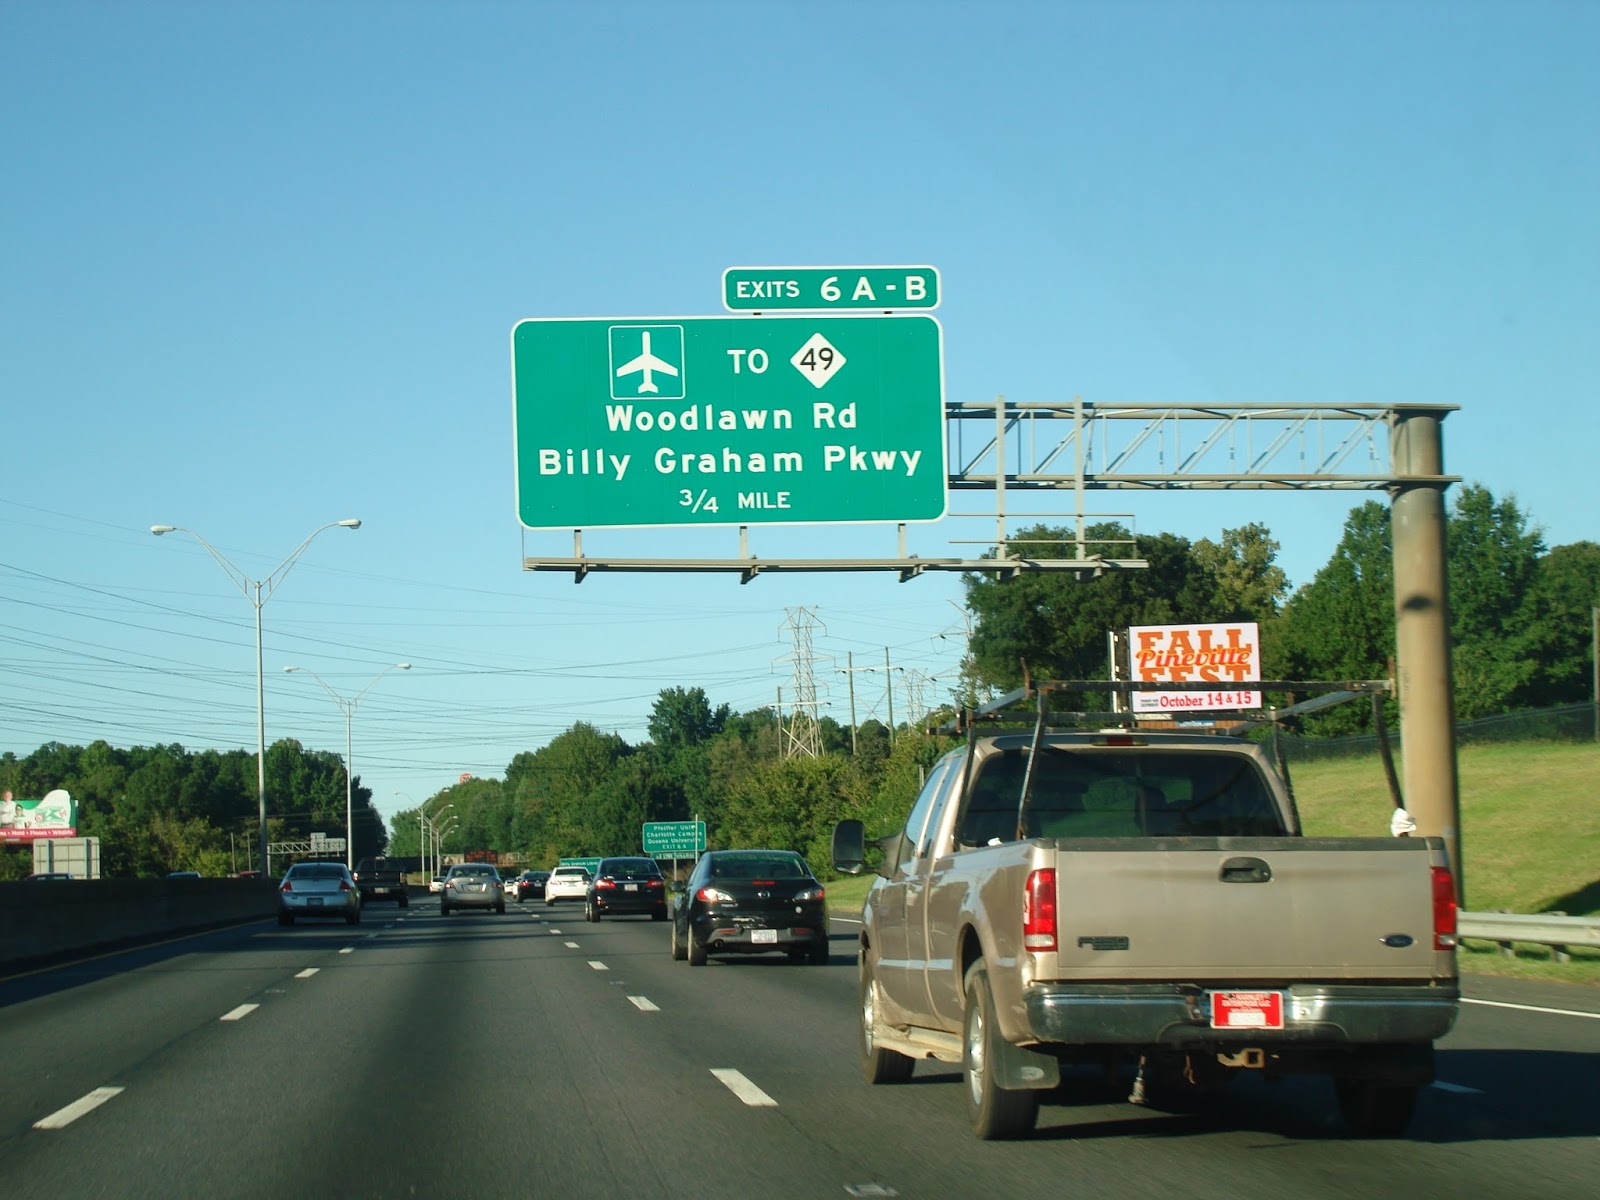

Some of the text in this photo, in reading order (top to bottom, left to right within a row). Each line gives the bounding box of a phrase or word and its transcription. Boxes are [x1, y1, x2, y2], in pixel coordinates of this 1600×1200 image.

[736, 280, 800, 299] EXITS
[820, 276, 841, 302] 6
[852, 276, 876, 301] A
[905, 276, 927, 301] B
[727, 349, 769, 374] TO
[800, 347, 833, 371] 49
[605, 402, 857, 432] Woodlawn Rd
[539, 445, 922, 480] Billy Graham Pkwy
[679, 488, 791, 513] 3/4 MILE
[1137, 629, 1252, 655] FALL
[1136, 647, 1251, 667] Pineville
[1160, 695, 1204, 707] October
[1207, 692, 1223, 705] 14
[1236, 690, 1252, 704] 15
